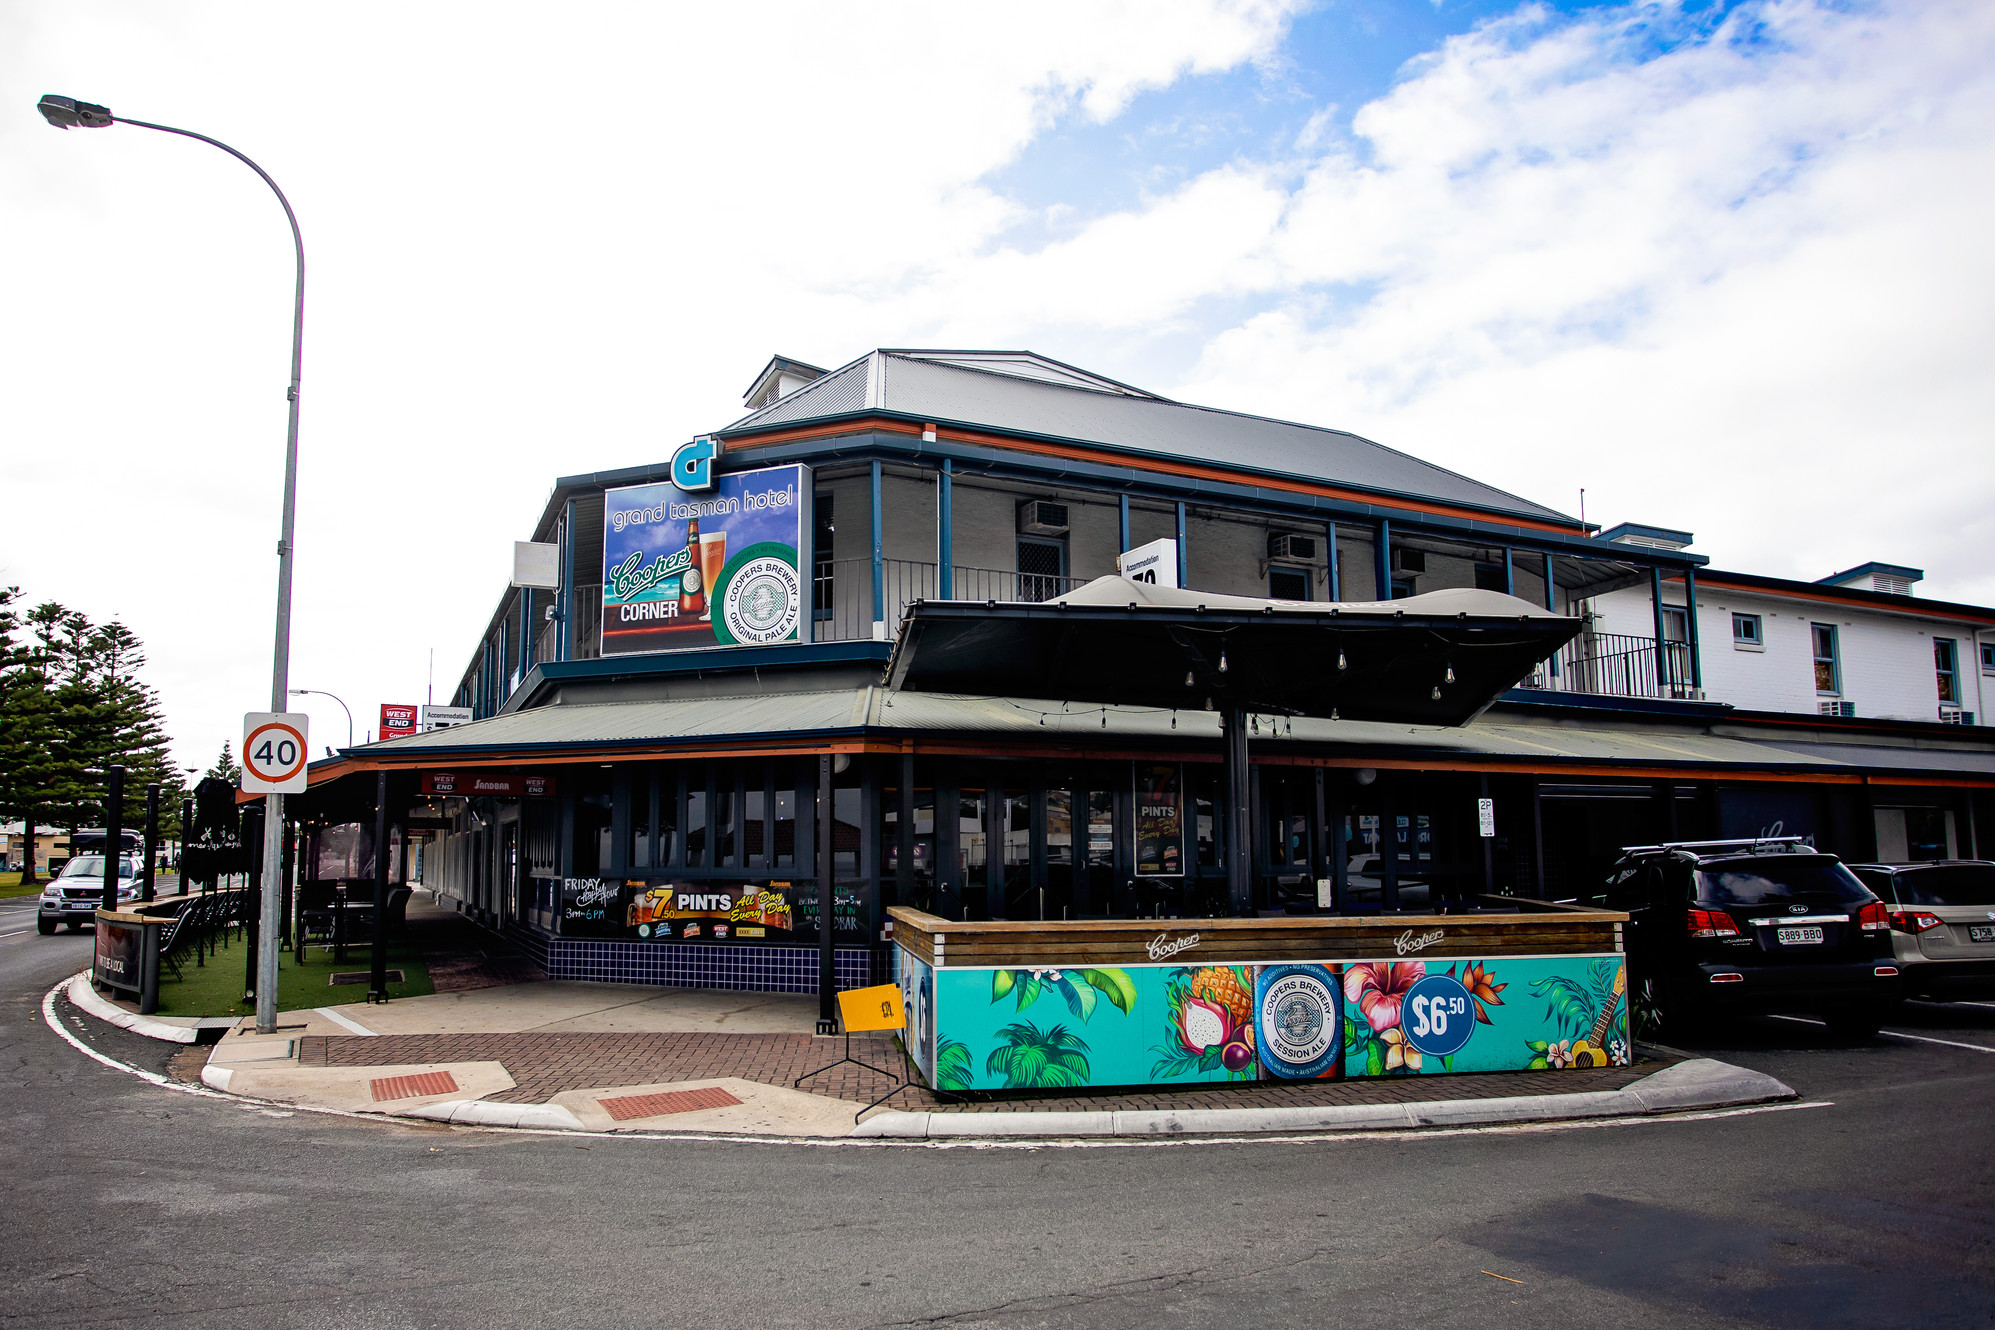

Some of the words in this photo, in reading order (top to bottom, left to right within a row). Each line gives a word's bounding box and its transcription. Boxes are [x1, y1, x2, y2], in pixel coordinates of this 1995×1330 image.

[613, 502, 665, 531] grand
[669, 497, 739, 520] tasman
[744, 484, 793, 511] hotel
[610, 546, 692, 601] Coopers
[1126, 554, 1160, 573] Accommodation
[730, 564, 763, 602] COOPERS
[766, 563, 798, 596] BREWERY
[620, 601, 679, 622] CORNER
[730, 612, 763, 642] ORIGINAL
[765, 624, 787, 641] PALE
[785, 605, 798, 625] ALE
[386, 710, 413, 718] WEST
[388, 719, 409, 727] END
[427, 712, 469, 721] Accommodation
[254, 740, 296, 766] 40
[474, 779, 510, 790] SANDBAR
[1141, 806, 1175, 817] PINTS
[1480, 801, 1491, 810] 2P
[1138, 830, 1161, 841] Every
[1163, 825, 1180, 836] Day
[1142, 820, 1154, 831] All
[1158, 817, 1175, 828] Day
[564, 878, 600, 891] FRIDAY
[678, 894, 732, 911] PINTS
[735, 894, 755, 909] All
[758, 891, 783, 904] Day
[730, 908, 763, 922] Every
[765, 901, 792, 915] Day
[1146, 932, 1200, 962] Coopers
[1393, 929, 1444, 956] Coopers
[1267, 965, 1289, 981] ADDITIVES
[1301, 964, 1334, 986] PRESERVATIVES
[1266, 981, 1297, 1016] COOPERS
[1299, 980, 1331, 1015] BREWERY
[1272, 1038, 1310, 1058] SESSION
[1311, 1037, 1327, 1053] ALE
[1261, 1046, 1281, 1070] AUSTRALIAN
[1281, 1067, 1295, 1075] MADE
[1299, 1060, 1328, 1075] AUSTRALIAN
